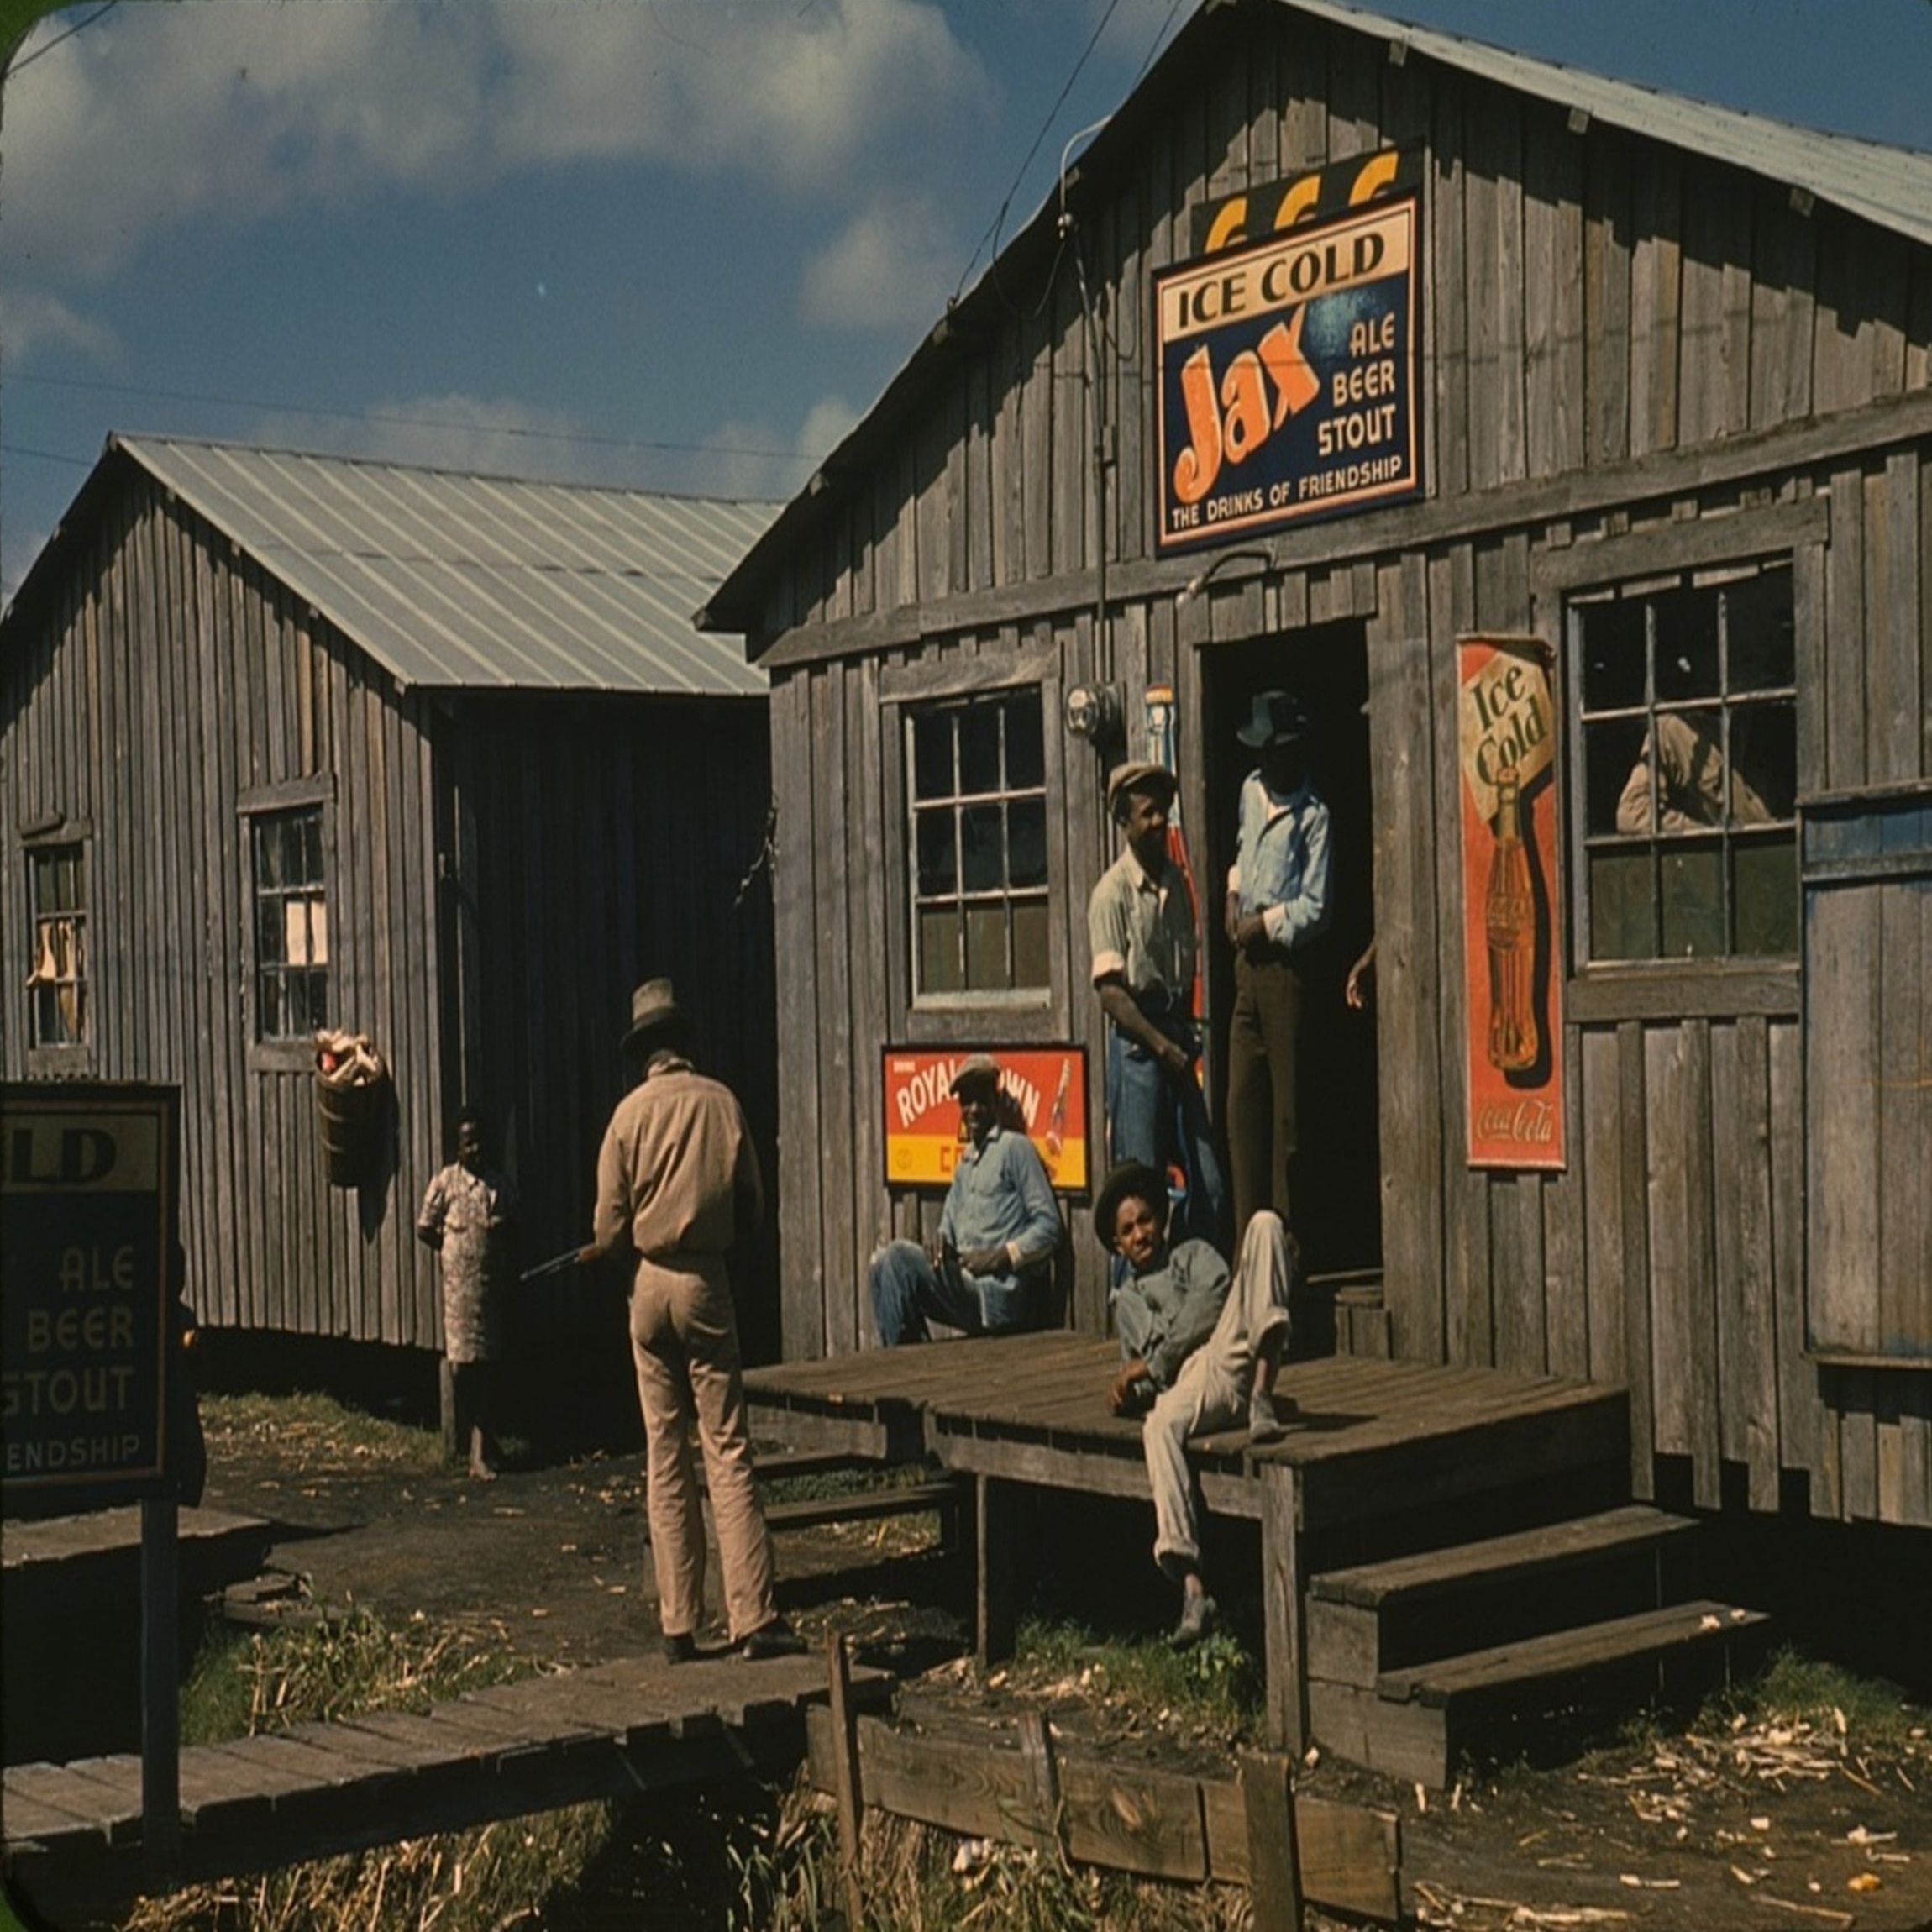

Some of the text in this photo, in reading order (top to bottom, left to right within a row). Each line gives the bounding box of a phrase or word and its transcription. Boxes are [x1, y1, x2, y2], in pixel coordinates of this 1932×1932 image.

[1179, 232, 1384, 328] ICE COLD
[1349, 312, 1395, 356] ALE
[1173, 302, 1320, 504] Jax
[1332, 360, 1395, 407] BEER
[1317, 403, 1396, 456] STOUT
[1172, 455, 1403, 530] THE DRINKS OF FRIENDSHIP
[1470, 665, 1527, 735] Ice
[1476, 692, 1547, 787] Cold
[59, 1245, 134, 1293] ALE
[28, 1307, 134, 1353] BEER
